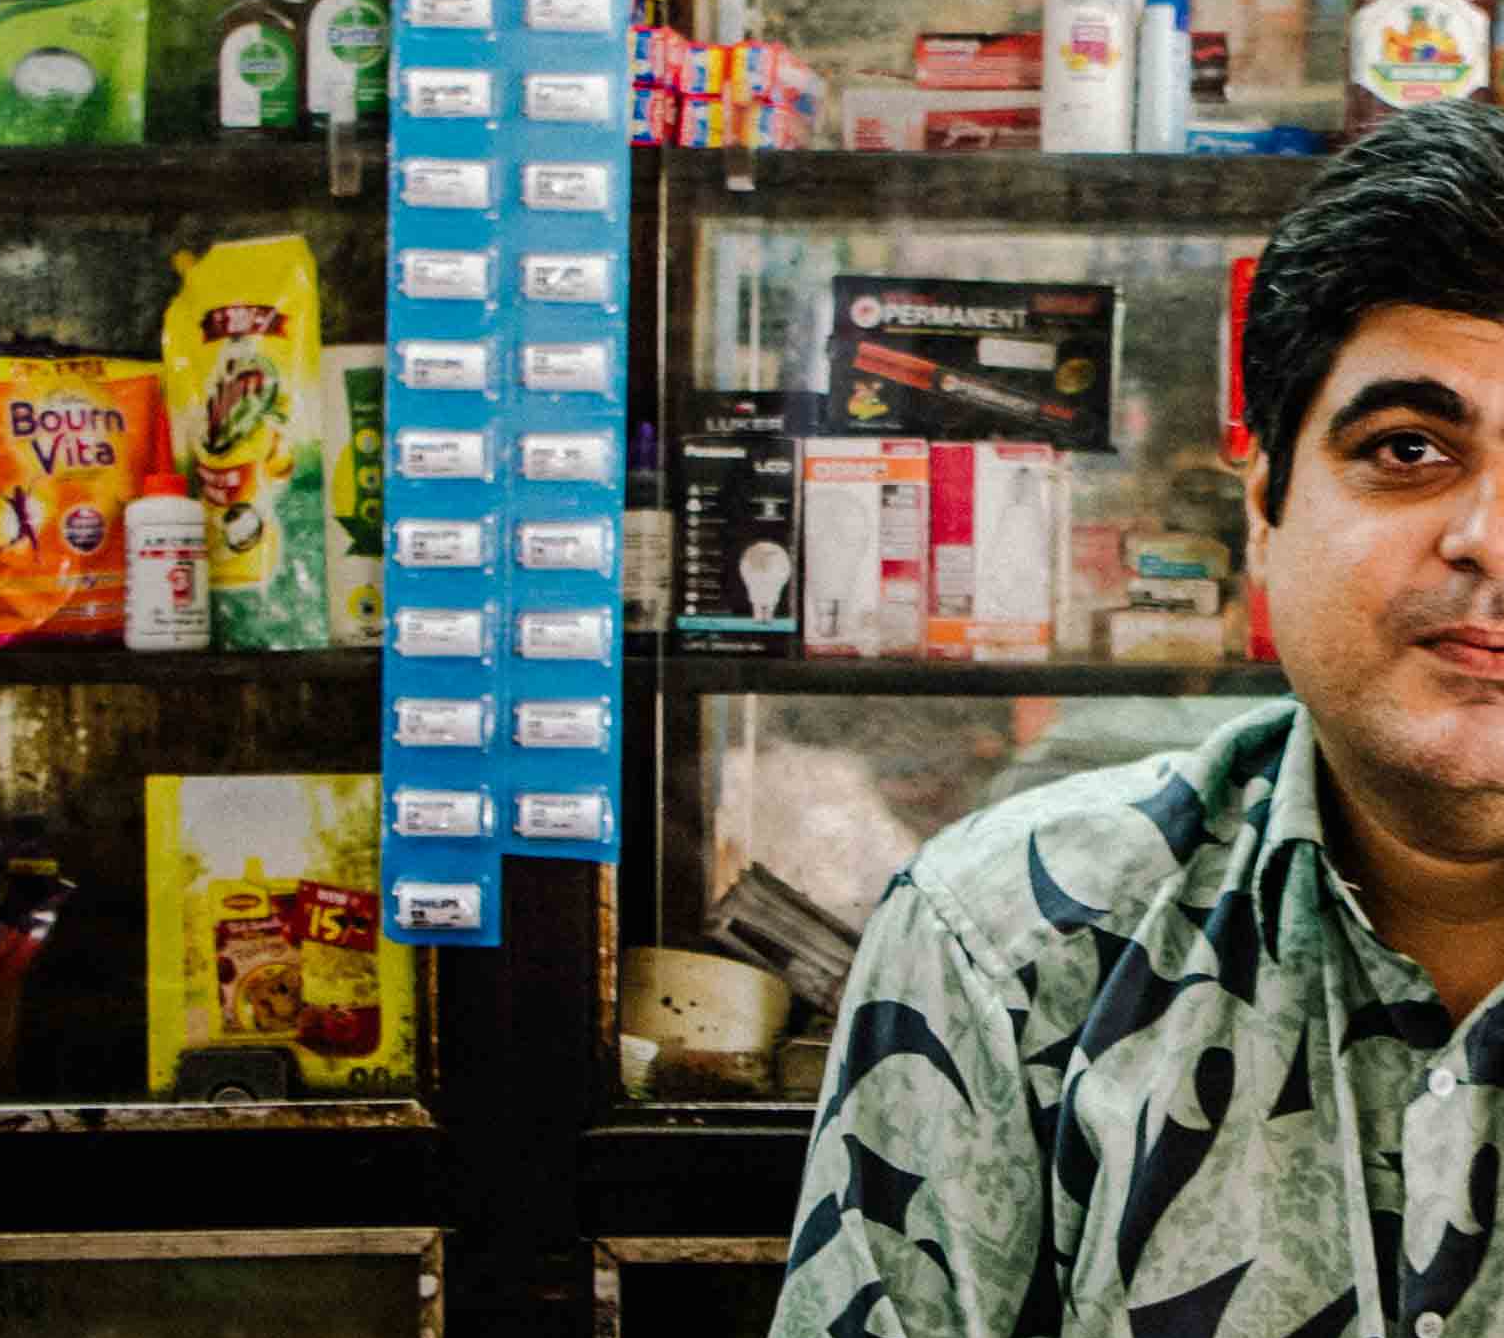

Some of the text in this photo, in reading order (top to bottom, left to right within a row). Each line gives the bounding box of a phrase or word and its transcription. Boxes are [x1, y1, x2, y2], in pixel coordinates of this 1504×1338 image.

[882, 301, 1029, 329] PERMANENT
[10, 402, 125, 437] Bourn
[32, 433, 116, 475] Vita
